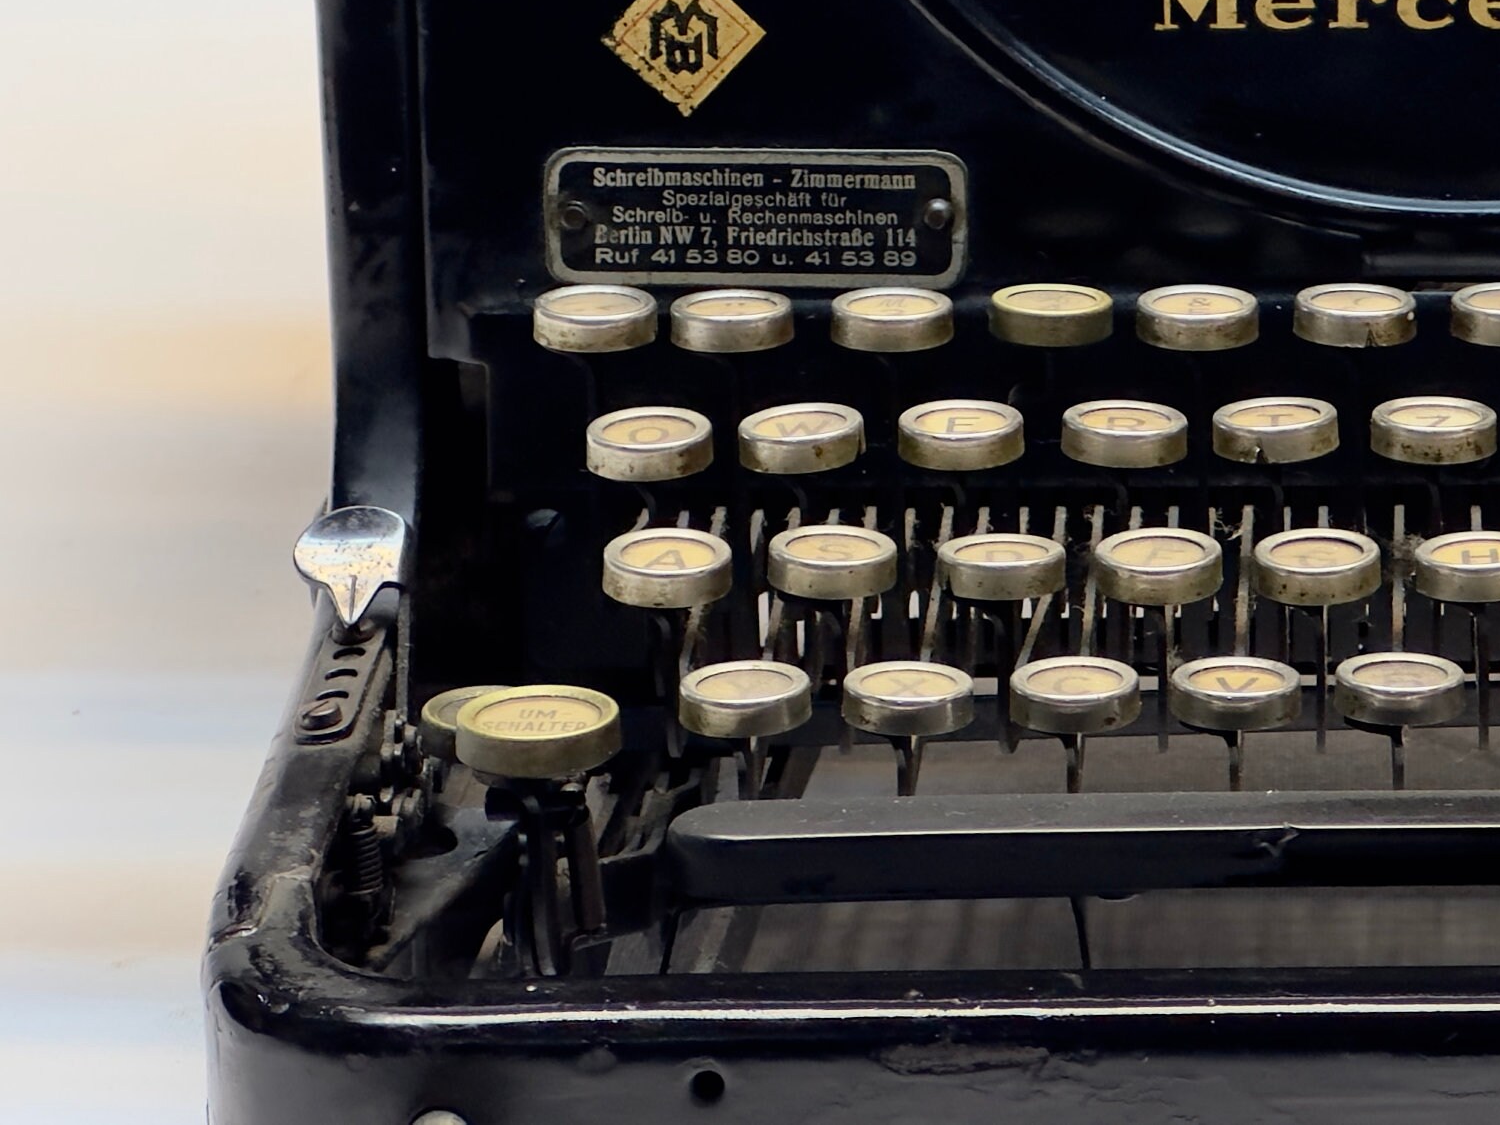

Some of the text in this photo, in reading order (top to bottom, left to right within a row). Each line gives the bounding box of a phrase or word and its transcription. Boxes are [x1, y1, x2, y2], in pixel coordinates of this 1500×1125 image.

[593, 167, 764, 187] Schreibmaschinen
[790, 168, 916, 189] Zimmermann
[662, 189, 847, 208] Spezialgeschäft für
[612, 206, 898, 225] Schreib- u. Rechenmaschinen
[594, 224, 916, 248] Berlin NW 7, Friedrichstraße 114
[595, 248, 917, 267] Ruf 41 53 80 u. 41 53 89
[1257, 413, 1294, 427] T
[643, 548, 688, 569] A
[814, 543, 855, 561] S
[1460, 547, 1500, 564] H
[885, 676, 929, 696] X
[1051, 675, 1093, 694] C
[1213, 676, 1259, 693] V
[519, 709, 573, 720] UM-
